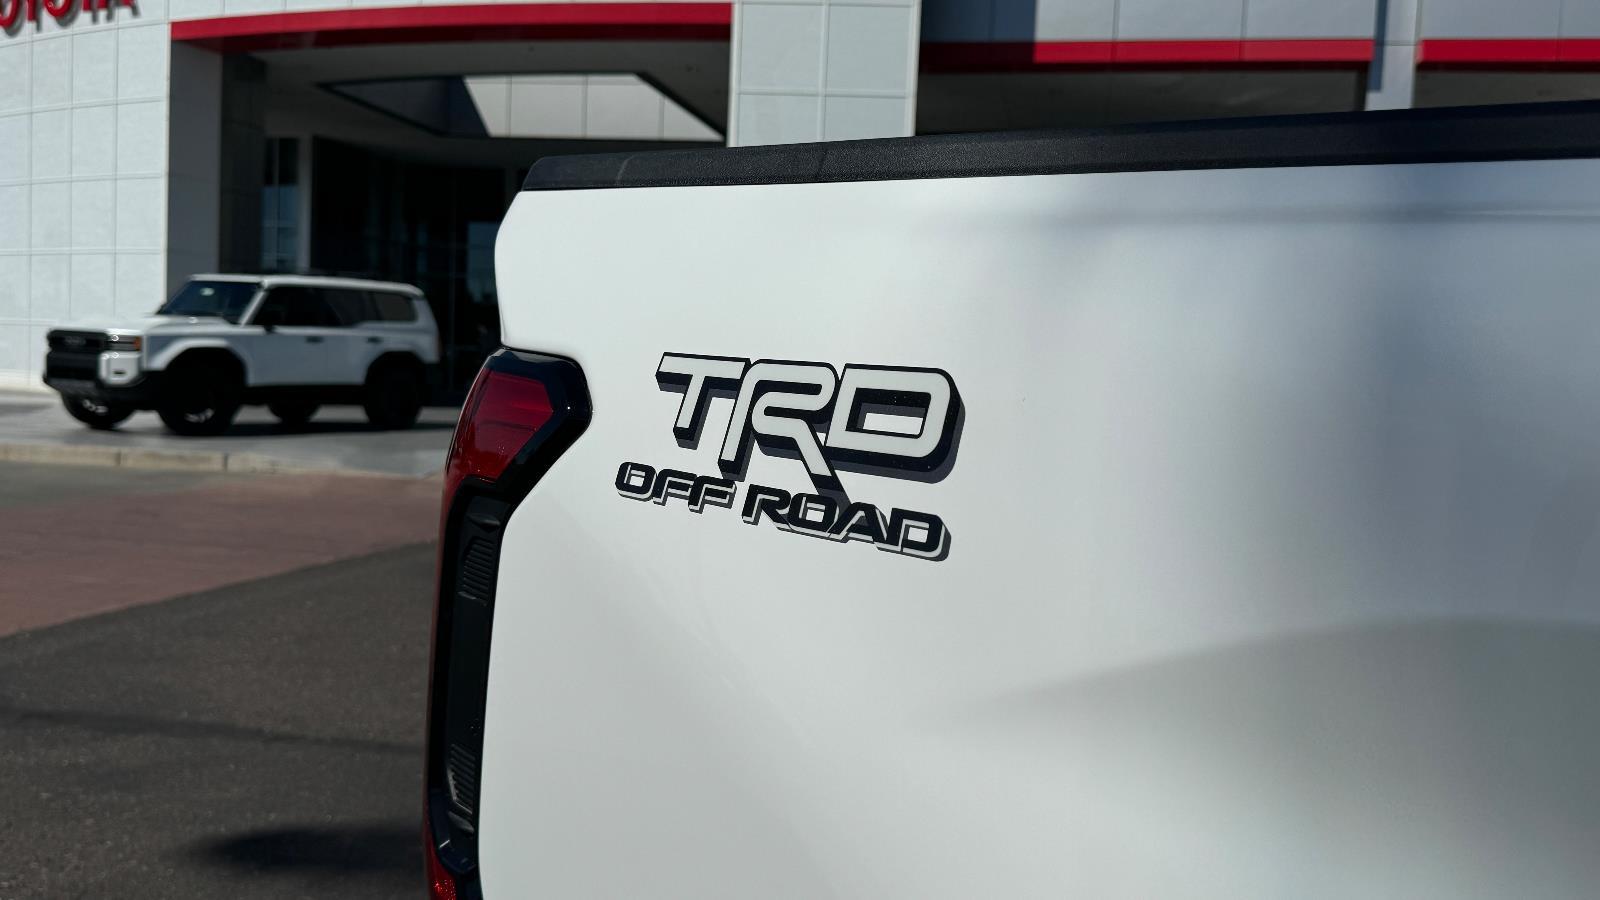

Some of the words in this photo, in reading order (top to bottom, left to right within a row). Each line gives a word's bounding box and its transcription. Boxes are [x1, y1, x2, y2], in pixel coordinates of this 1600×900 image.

[655, 351, 965, 498] TRD
[615, 462, 737, 513] OFF
[742, 484, 951, 561] ROAD
